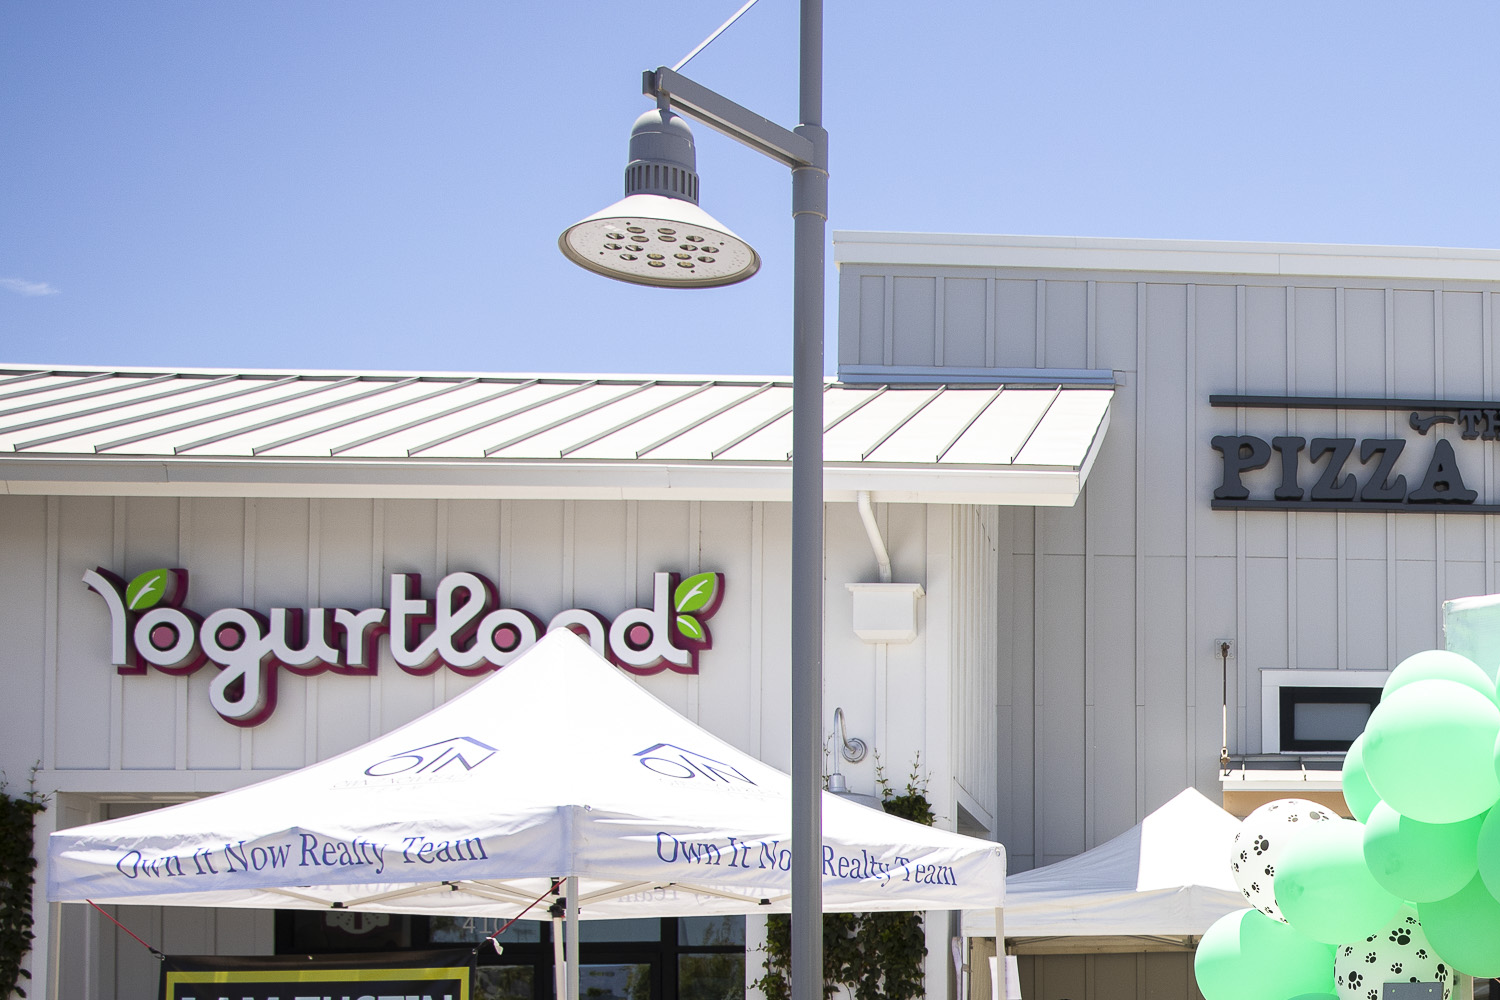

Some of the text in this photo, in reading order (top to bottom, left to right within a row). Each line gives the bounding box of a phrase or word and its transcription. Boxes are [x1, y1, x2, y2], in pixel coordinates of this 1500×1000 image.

[1211, 435, 1479, 504] PIZZA
[116, 833, 489, 879] Own It Now Realty Team
[656, 831, 959, 888] Own It No Realty Team
[461, 916, 508, 934] 410
